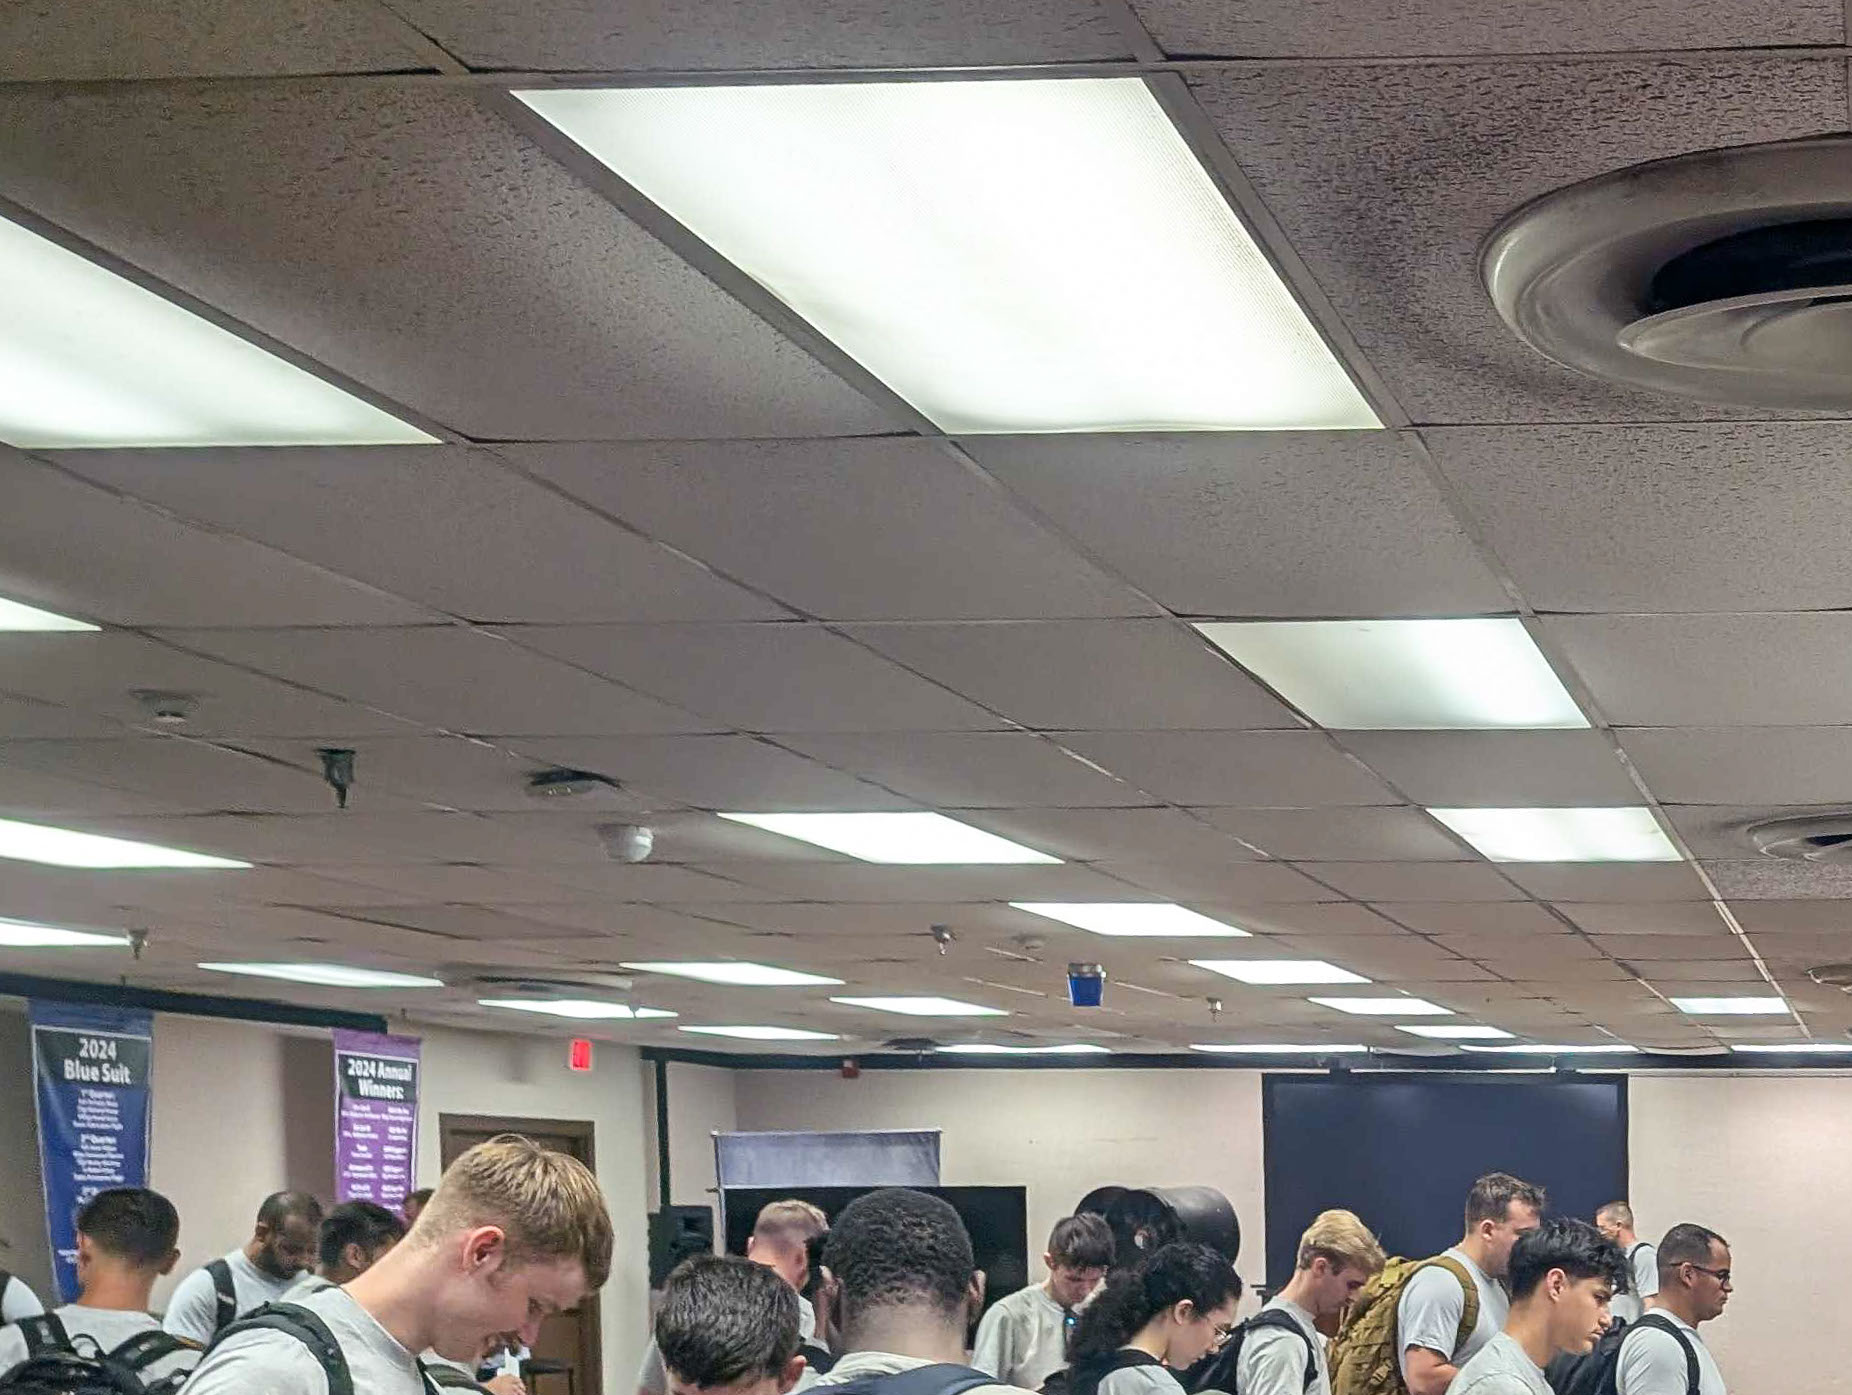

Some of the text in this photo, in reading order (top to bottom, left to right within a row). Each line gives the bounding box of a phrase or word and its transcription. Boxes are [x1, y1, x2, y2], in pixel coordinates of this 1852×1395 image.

[79, 1037, 117, 1060] 2024
[63, 1058, 132, 1085] Blue Suit
[347, 1057, 412, 1081] 2024 Annual
[358, 1078, 404, 1100] Winners
